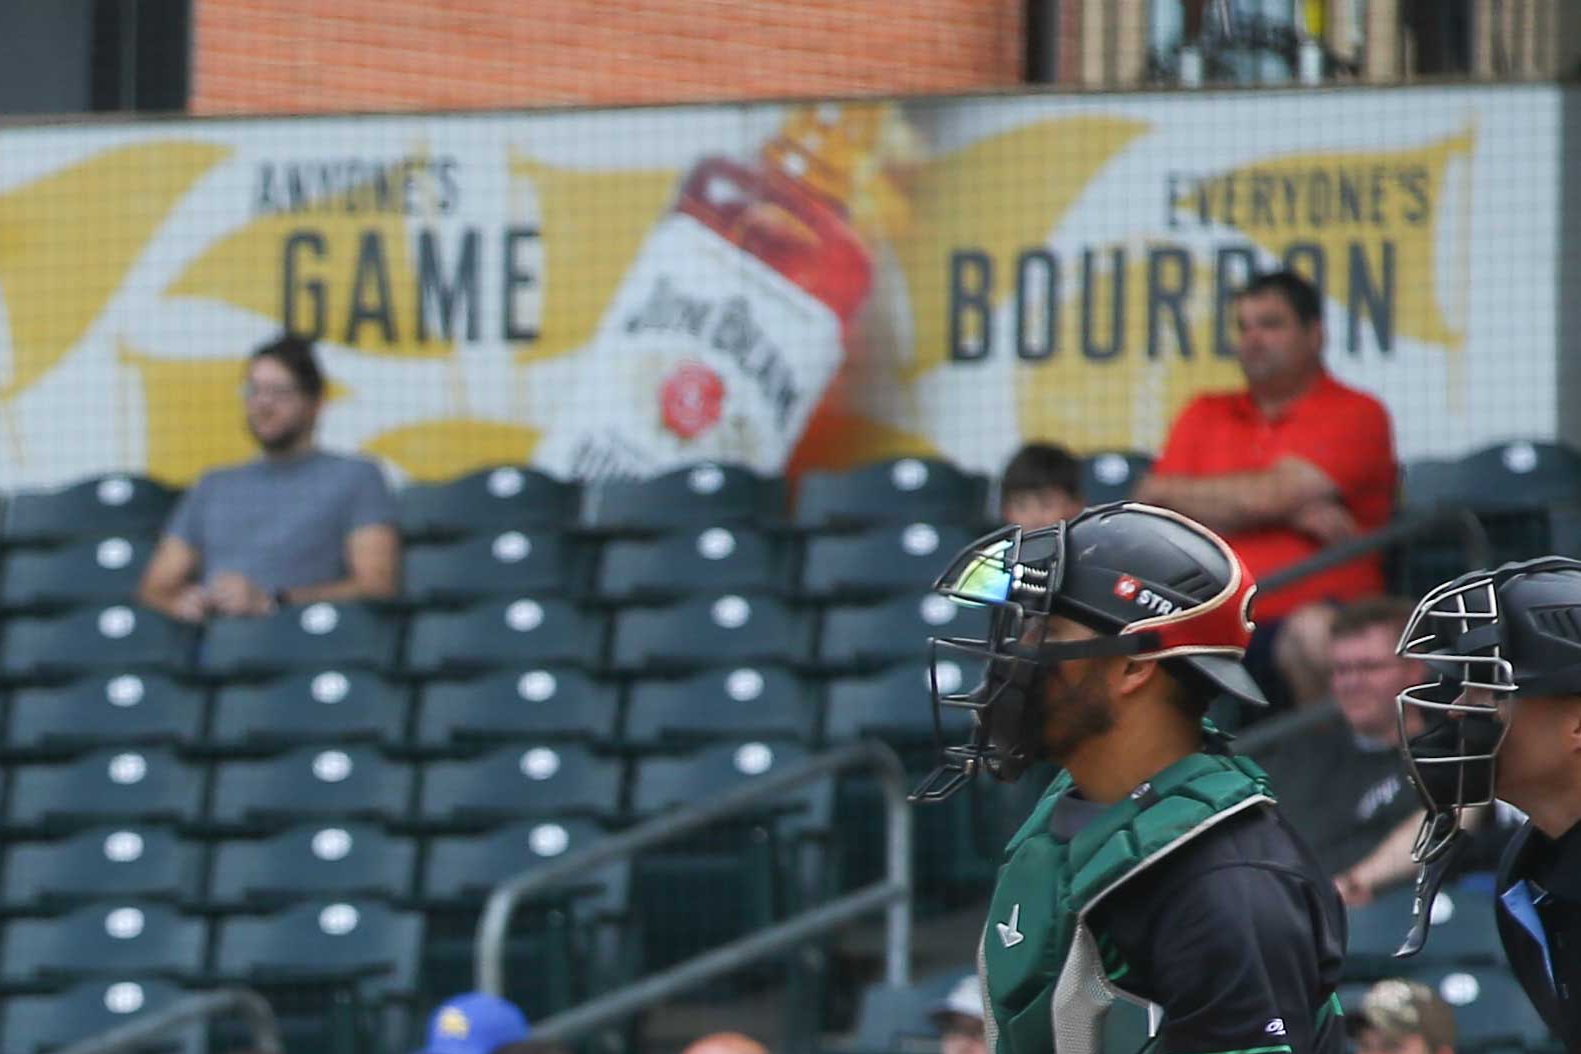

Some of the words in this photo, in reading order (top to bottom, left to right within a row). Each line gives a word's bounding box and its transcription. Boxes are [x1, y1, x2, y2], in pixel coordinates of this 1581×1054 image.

[1165, 165, 1429, 229] EVERYONE'S
[283, 226, 541, 346] GAME
[1137, 589, 1183, 617] STR
